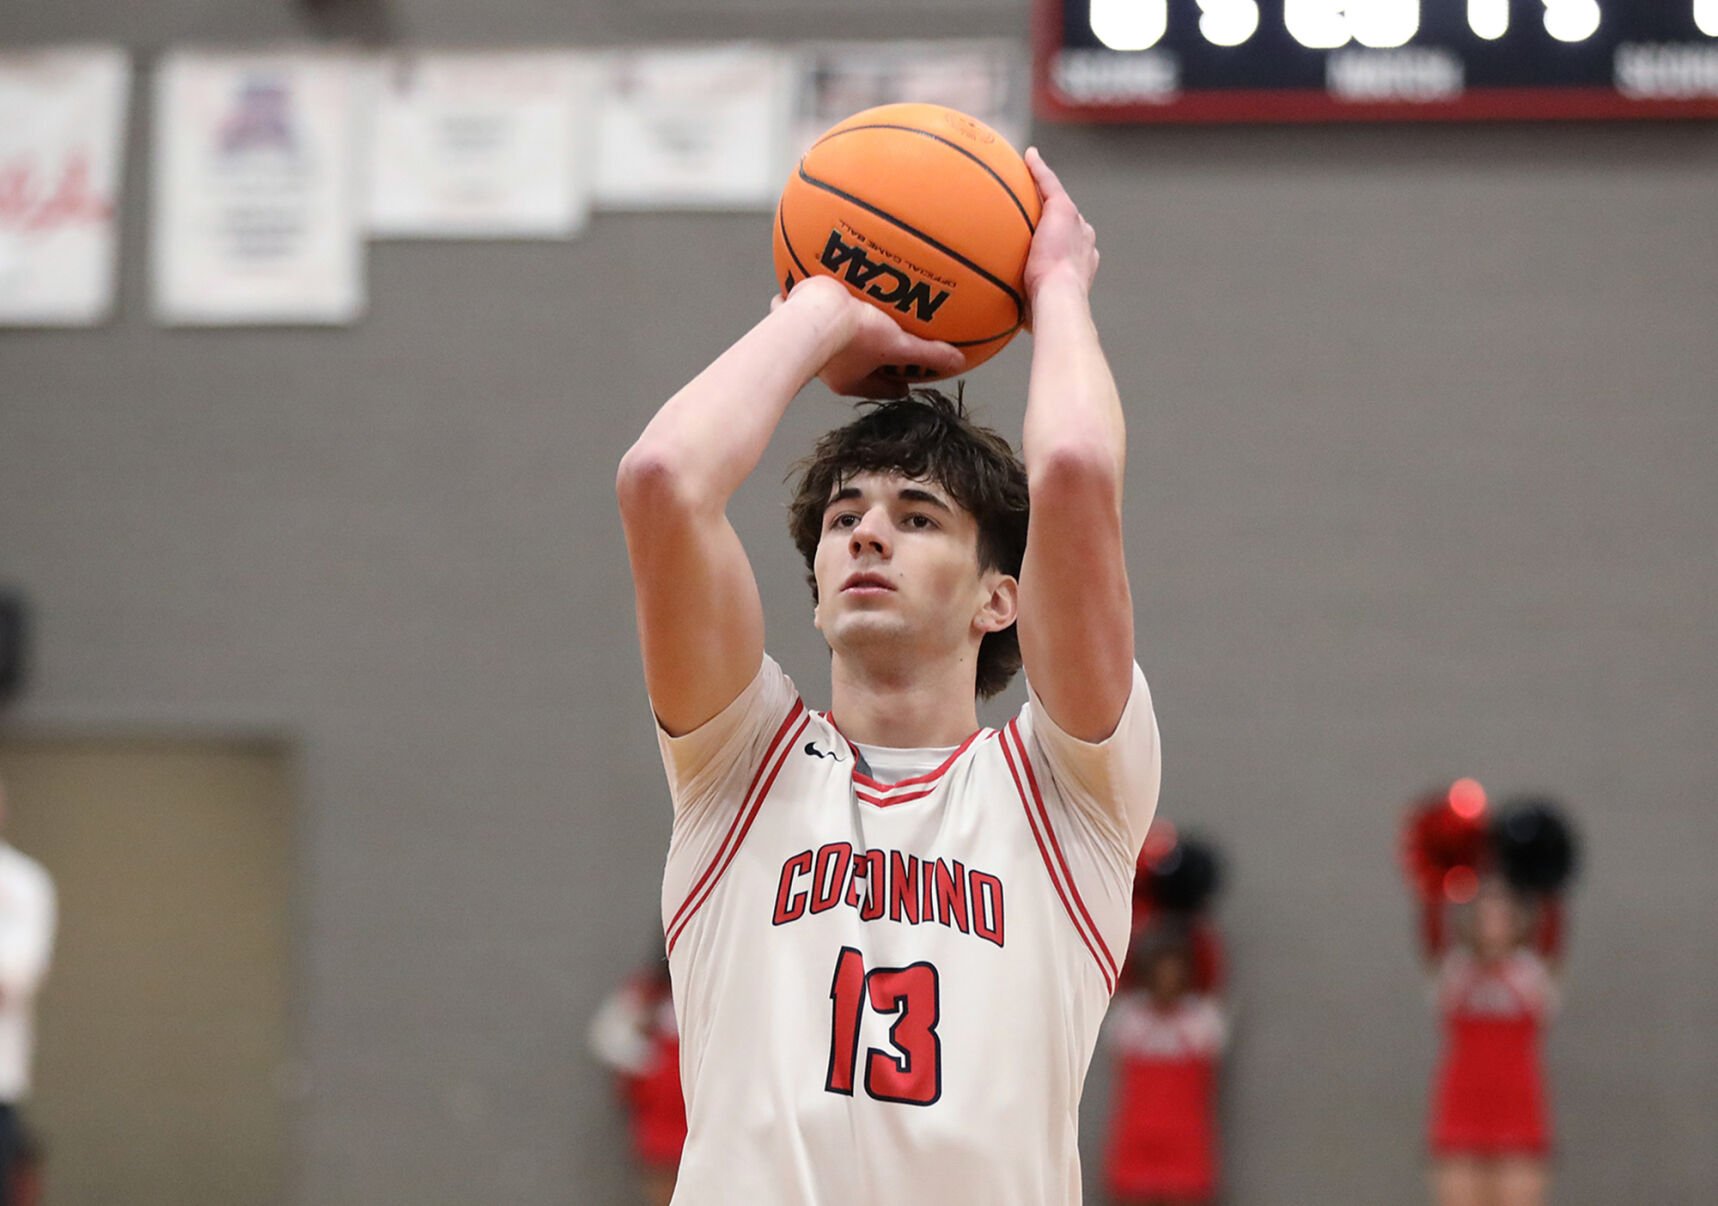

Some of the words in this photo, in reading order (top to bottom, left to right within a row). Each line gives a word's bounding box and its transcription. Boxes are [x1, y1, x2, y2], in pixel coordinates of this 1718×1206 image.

[839, 220, 867, 241] BALL
[868, 241, 902, 264] GAME
[820, 229, 950, 322] NCAA
[906, 261, 957, 288] OFFICIAL
[824, 946, 942, 1107] 13
